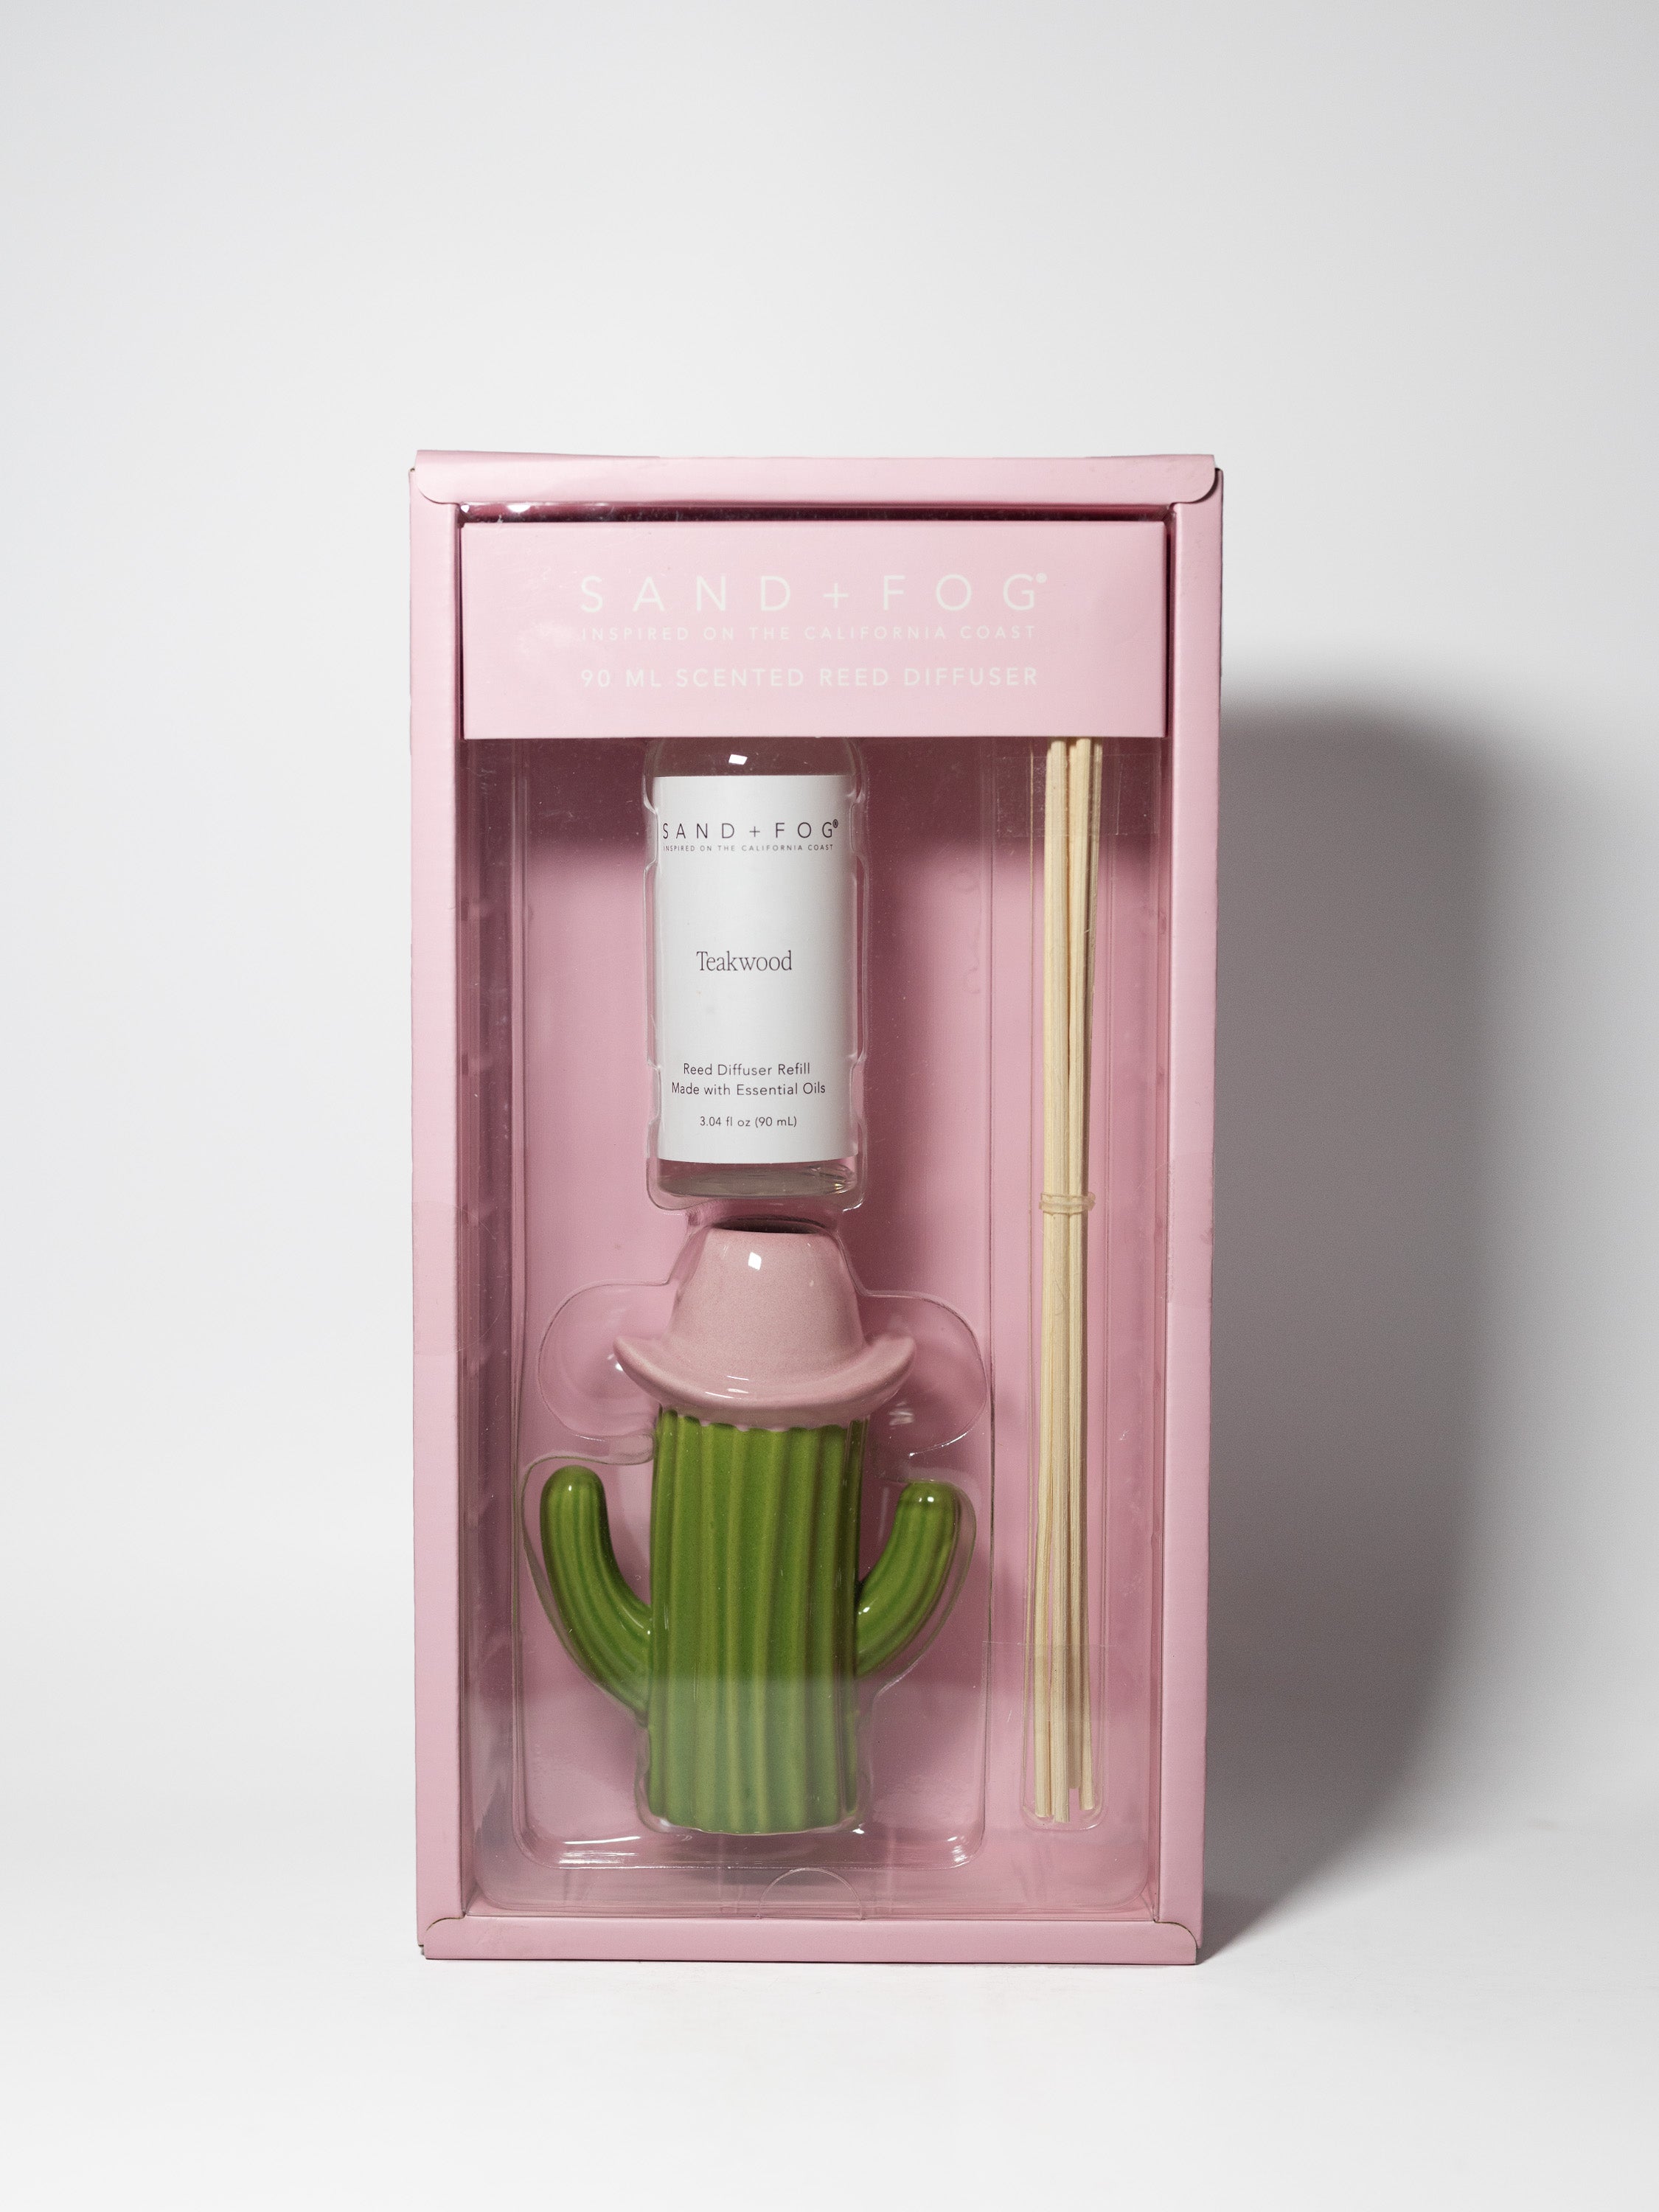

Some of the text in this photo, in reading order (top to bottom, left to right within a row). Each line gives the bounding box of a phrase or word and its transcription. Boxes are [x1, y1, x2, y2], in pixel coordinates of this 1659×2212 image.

[581, 575, 792, 613] SAND
[822, 582, 849, 609] +
[581, 625, 1035, 641] INSPIRED ON THE CALIFORNIA COAST
[581, 667, 1037, 688] 90 ML SCENTED REED DIFFUSER
[662, 822, 735, 839] SAND
[748, 826, 761, 838] +
[699, 844, 712, 852] ON
[717, 844, 735, 852] THE
[741, 844, 803, 852] CALIFORNIA
[695, 950, 793, 972] Teakwood
[683, 1062, 810, 1076] Reed Diffuser Refill
[672, 1081, 826, 1096] Made with Essential Oils
[700, 1116, 797, 1128] 3.04 fl oz (90 mL)
